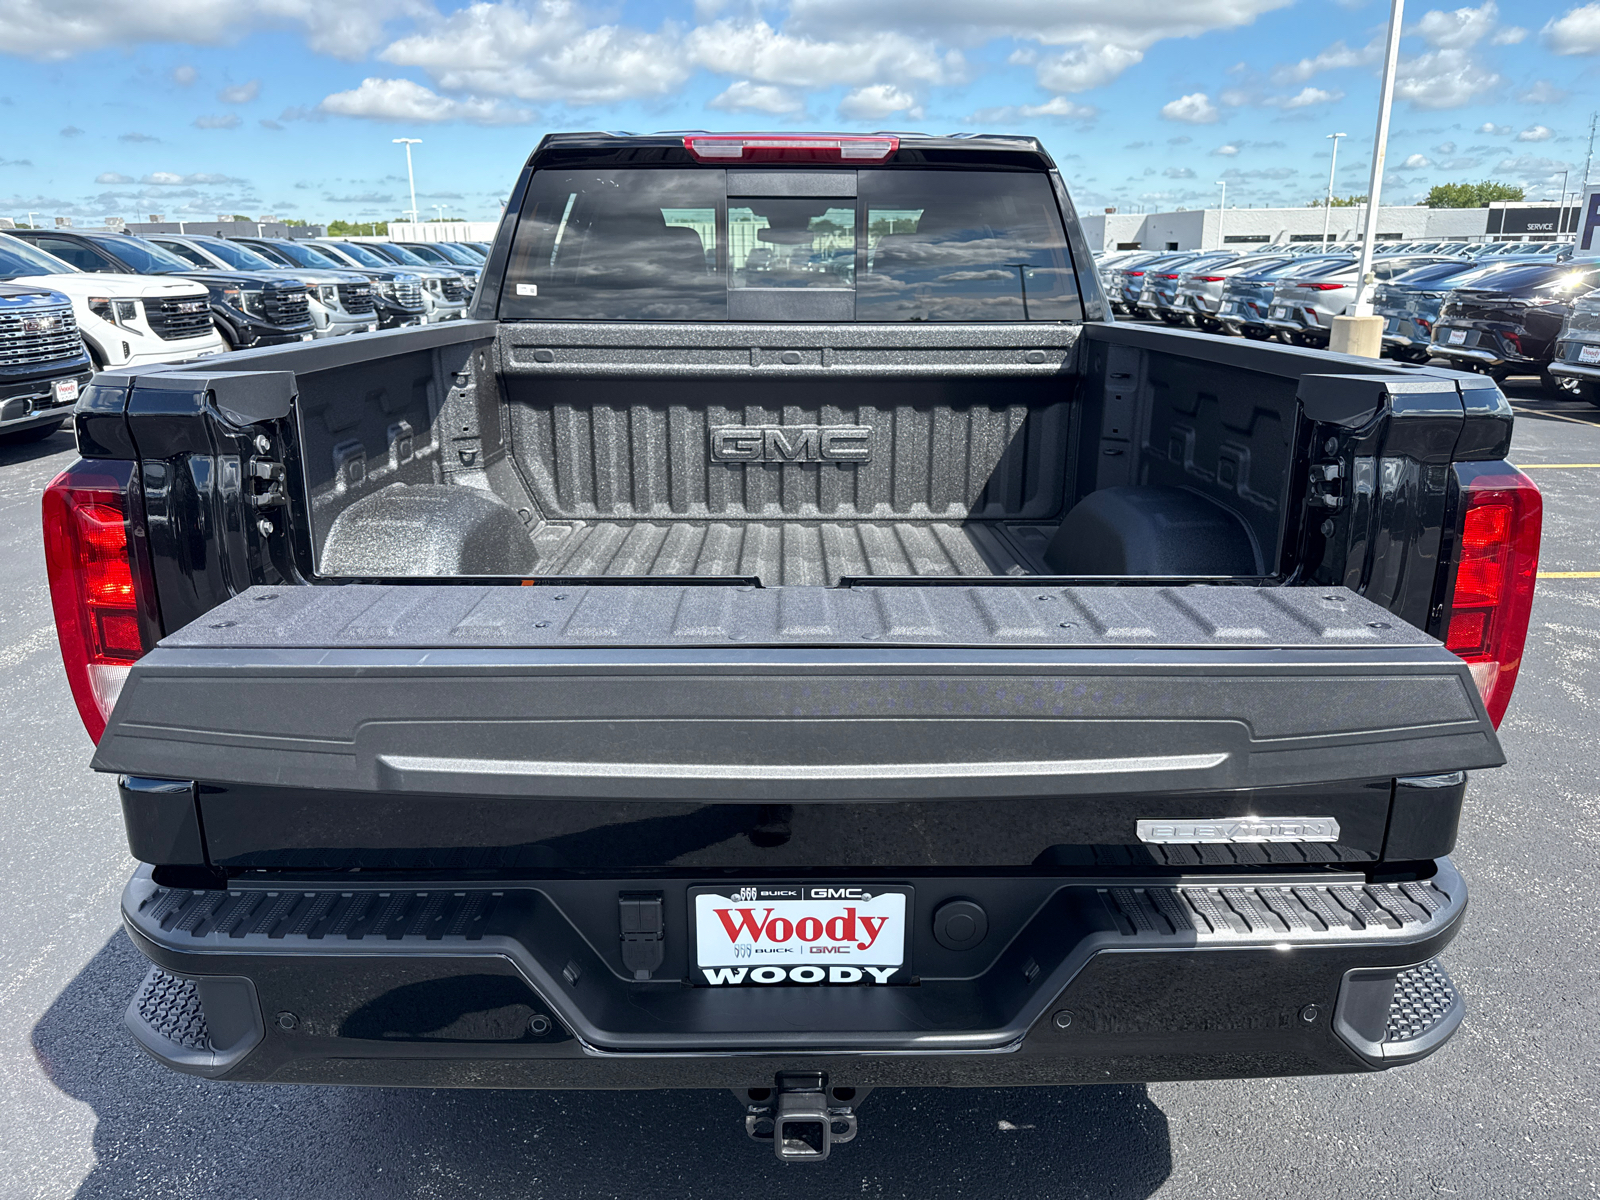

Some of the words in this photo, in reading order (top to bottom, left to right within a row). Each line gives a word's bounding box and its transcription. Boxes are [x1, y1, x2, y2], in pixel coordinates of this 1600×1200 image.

[1527, 223, 1554, 231] SERVICE
[713, 428, 870, 459] GMC
[1151, 820, 1326, 838] ELEVATION
[810, 888, 863, 899] GMC
[713, 907, 889, 950] Woody
[809, 946, 851, 954] GMC
[702, 966, 900, 985] WOODY
